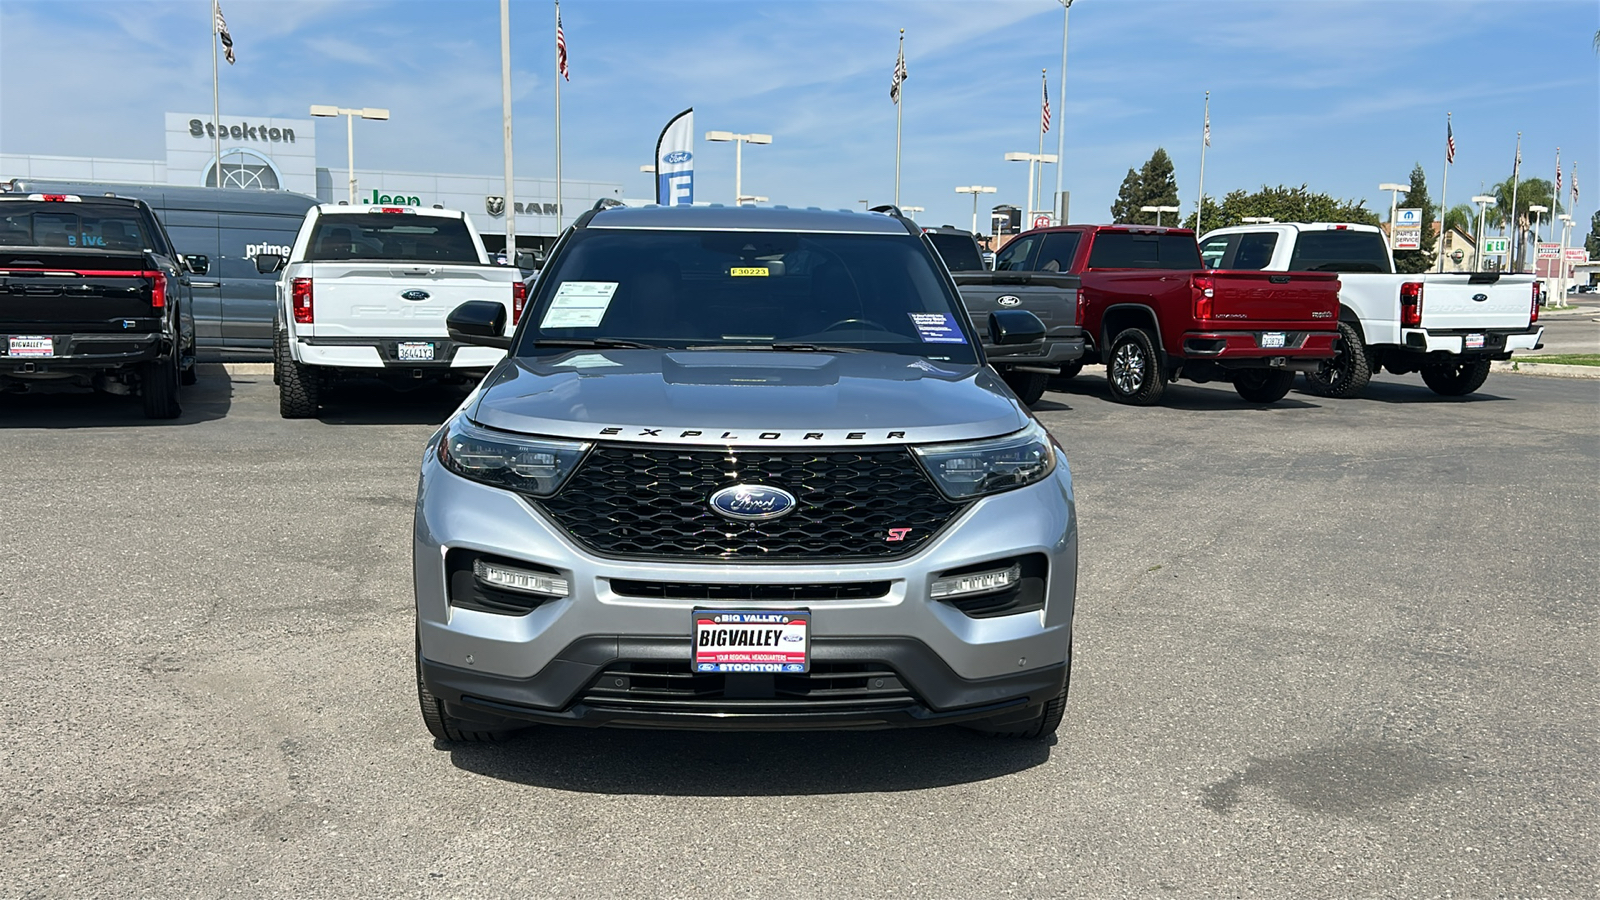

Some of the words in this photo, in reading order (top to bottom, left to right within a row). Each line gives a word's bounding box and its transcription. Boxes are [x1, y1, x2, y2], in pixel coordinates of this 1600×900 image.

[189, 118, 296, 143] Stockton
[363, 189, 421, 207] Jeep
[513, 202, 563, 216] RAM
[246, 241, 291, 259] prime
[599, 427, 907, 441] EXPLORER
[730, 490, 776, 511] Ford
[886, 527, 912, 542] ST
[721, 614, 741, 622] BIG
[743, 614, 783, 623] VALLEY
[699, 629, 783, 647] BIGVALLEY
[719, 663, 783, 672] STOCKTON
